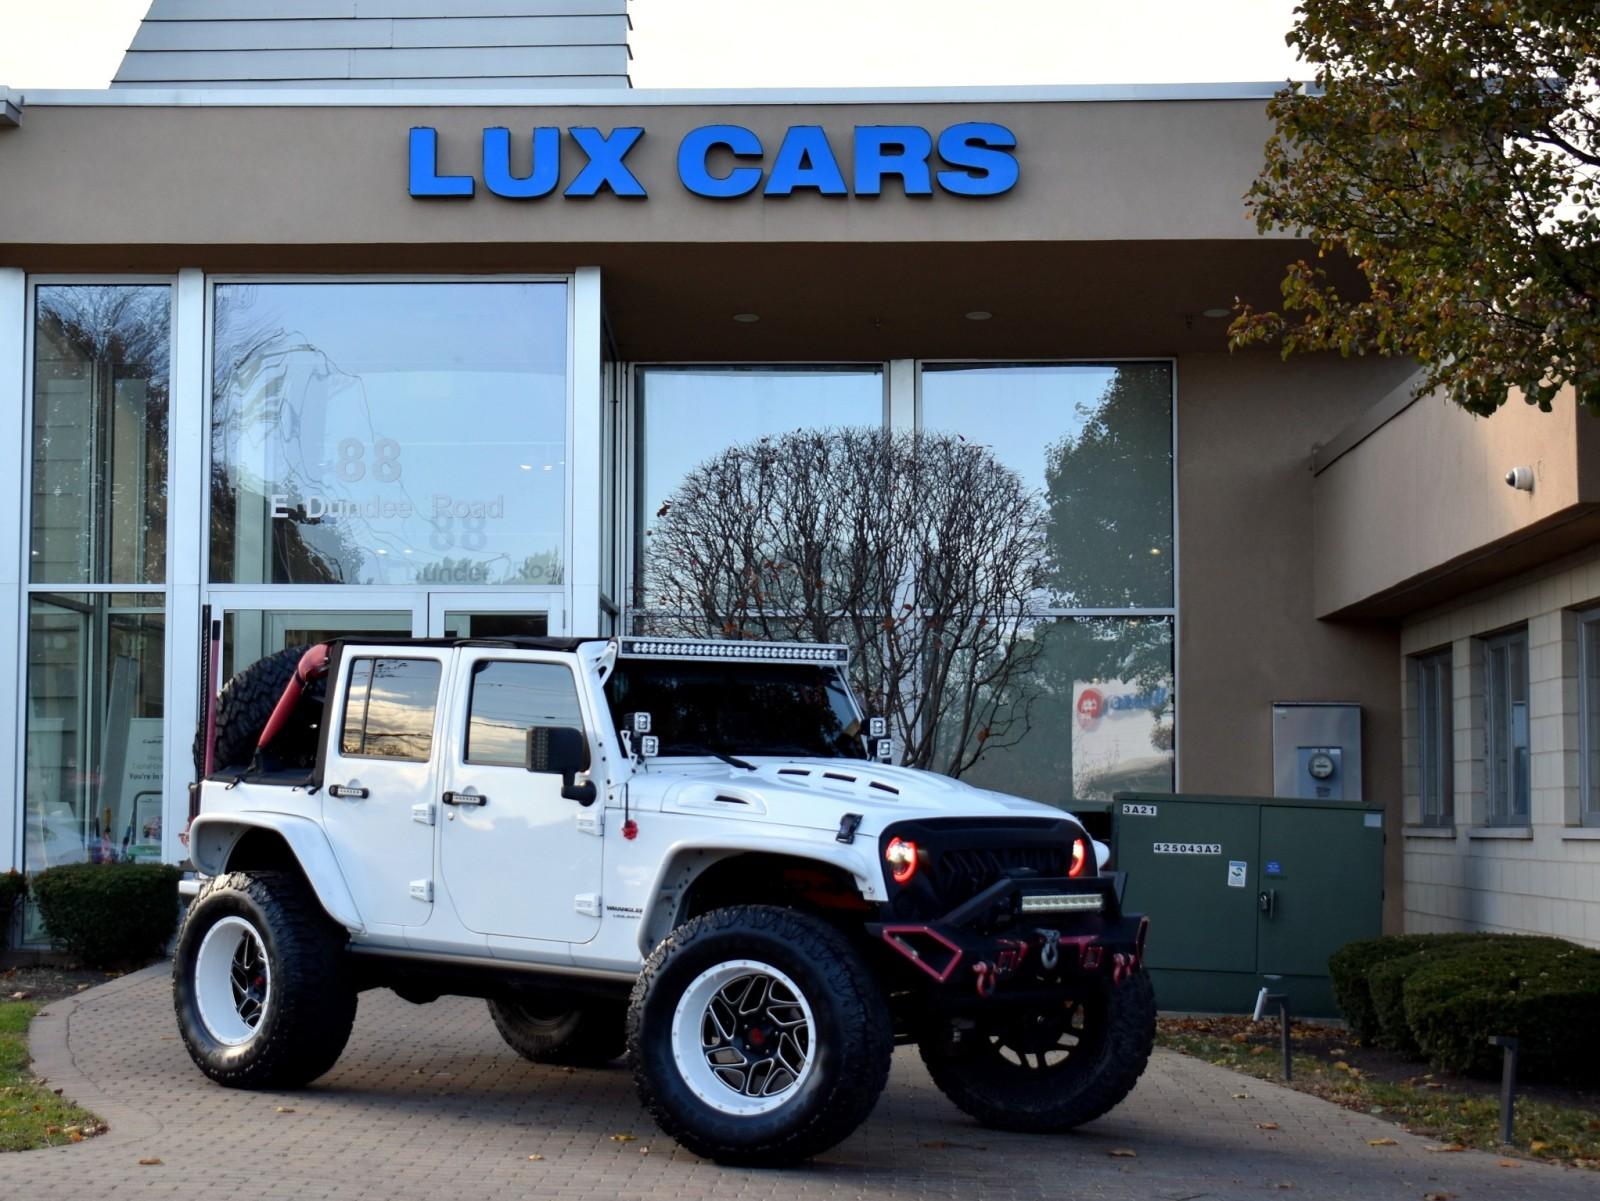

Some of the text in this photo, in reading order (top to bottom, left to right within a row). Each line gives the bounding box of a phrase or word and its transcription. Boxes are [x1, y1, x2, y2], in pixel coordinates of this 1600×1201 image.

[408, 121, 1020, 199] LUX CARS
[335, 437, 402, 483] 88
[270, 494, 505, 518] E Dundee Road
[1124, 804, 1156, 815] 3A21
[1154, 843, 1221, 853] 425043A2
